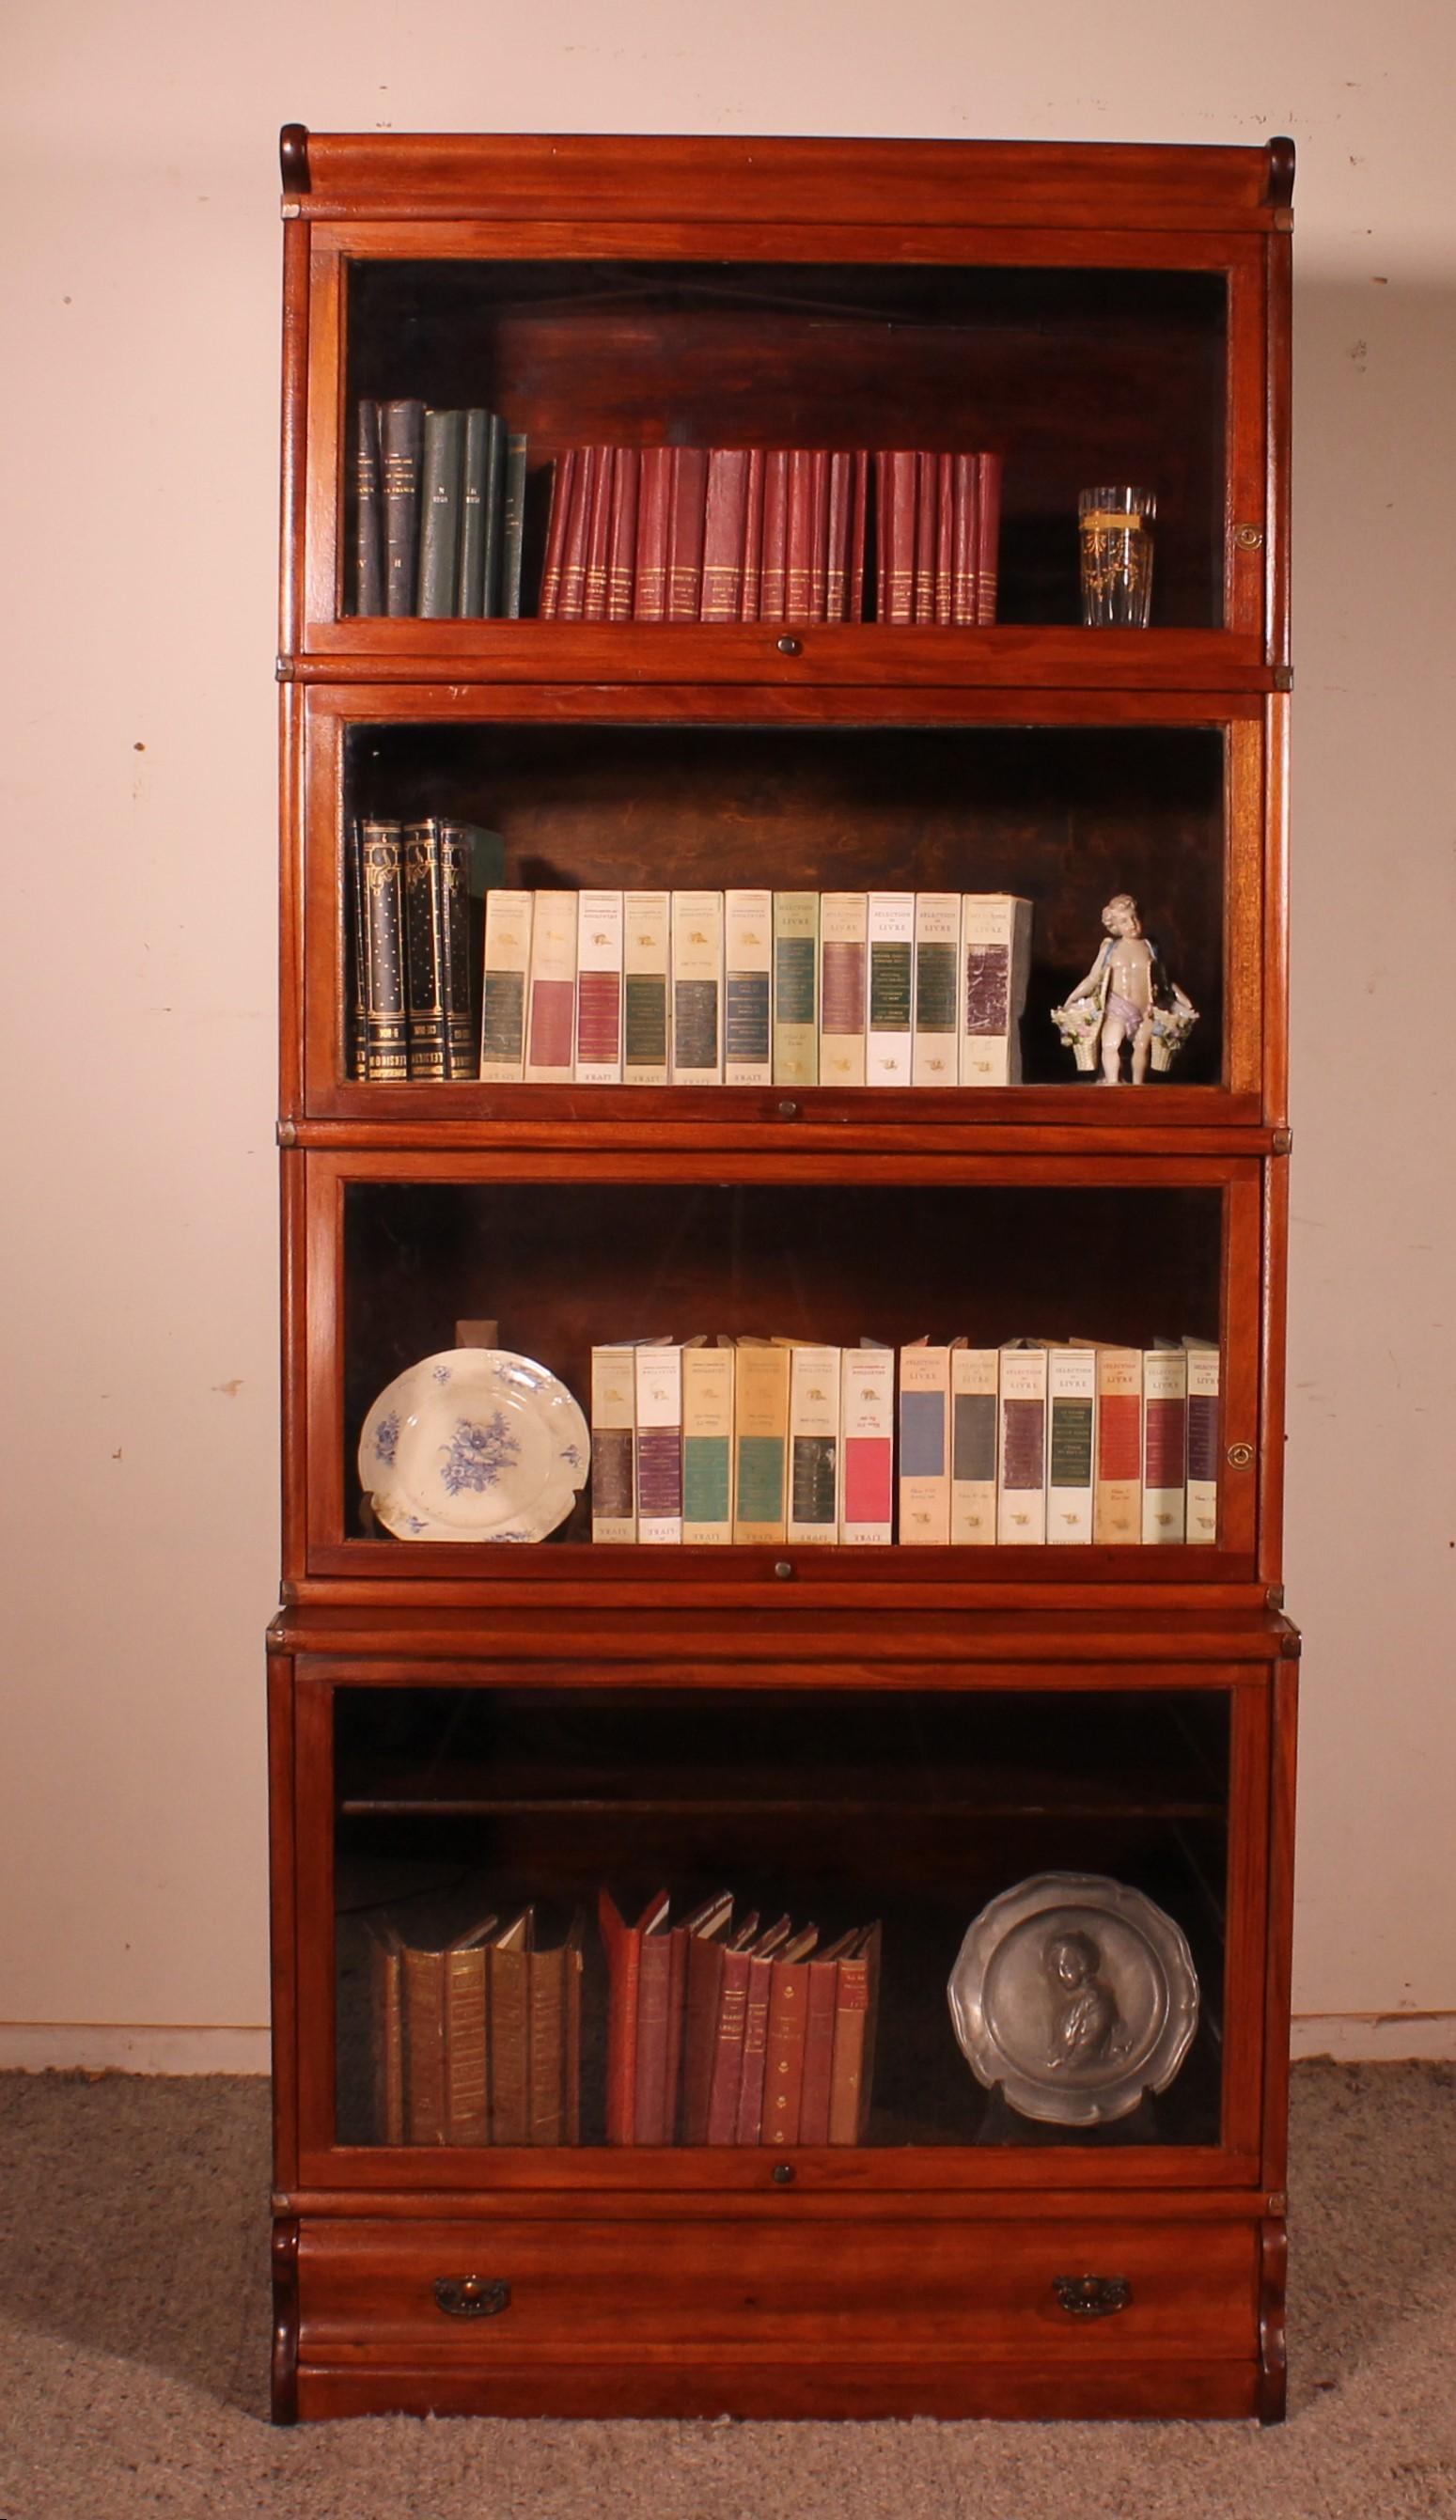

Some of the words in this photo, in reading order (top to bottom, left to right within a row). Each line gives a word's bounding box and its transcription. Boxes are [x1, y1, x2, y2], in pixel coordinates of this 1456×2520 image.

[782, 917, 810, 926] LIVRE
[830, 923, 857, 931] LIVRE
[925, 924, 951, 932] LIVRE
[585, 1073, 611, 1082] LIVRE
[734, 1074, 761, 1083] LIVRE
[962, 1375, 990, 1384] LIVRE
[1060, 1379, 1088, 1387] LIVRE
[1106, 1375, 1134, 1384] LIVRE
[599, 1527, 626, 1536] LIVRE
[648, 1527, 675, 1536] LIVRE
